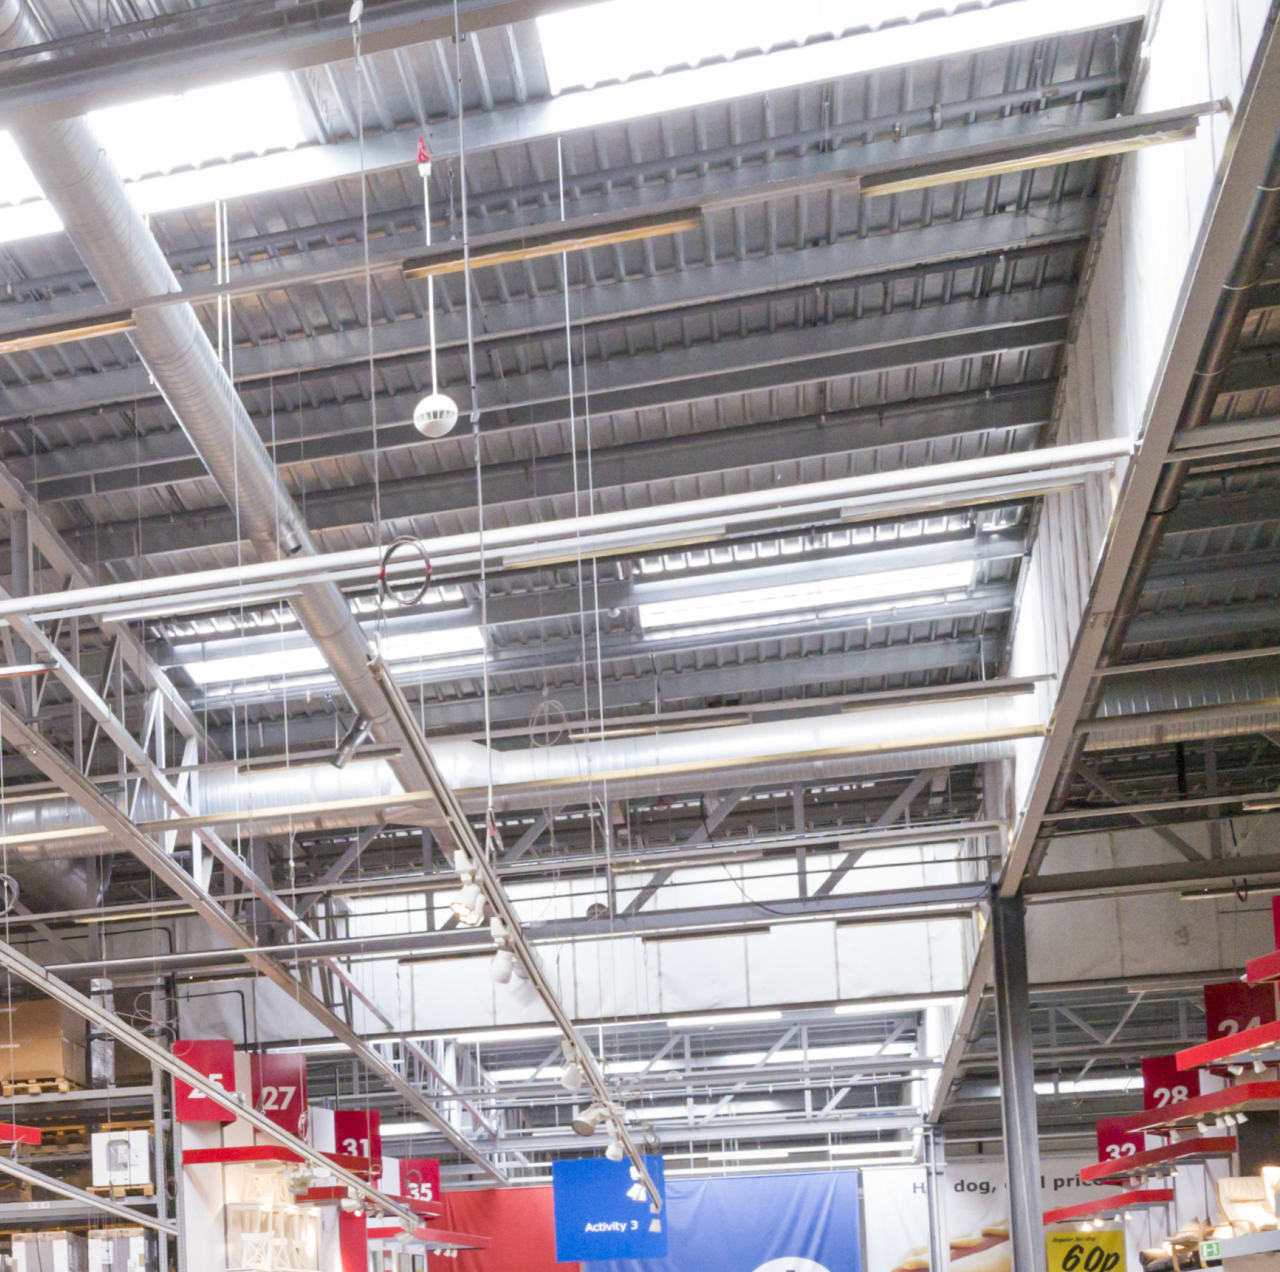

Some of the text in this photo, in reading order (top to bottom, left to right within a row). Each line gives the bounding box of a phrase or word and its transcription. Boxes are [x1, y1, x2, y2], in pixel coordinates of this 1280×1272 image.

[261, 1086, 296, 1111] 27
[585, 1220, 638, 1232] Activity 3
